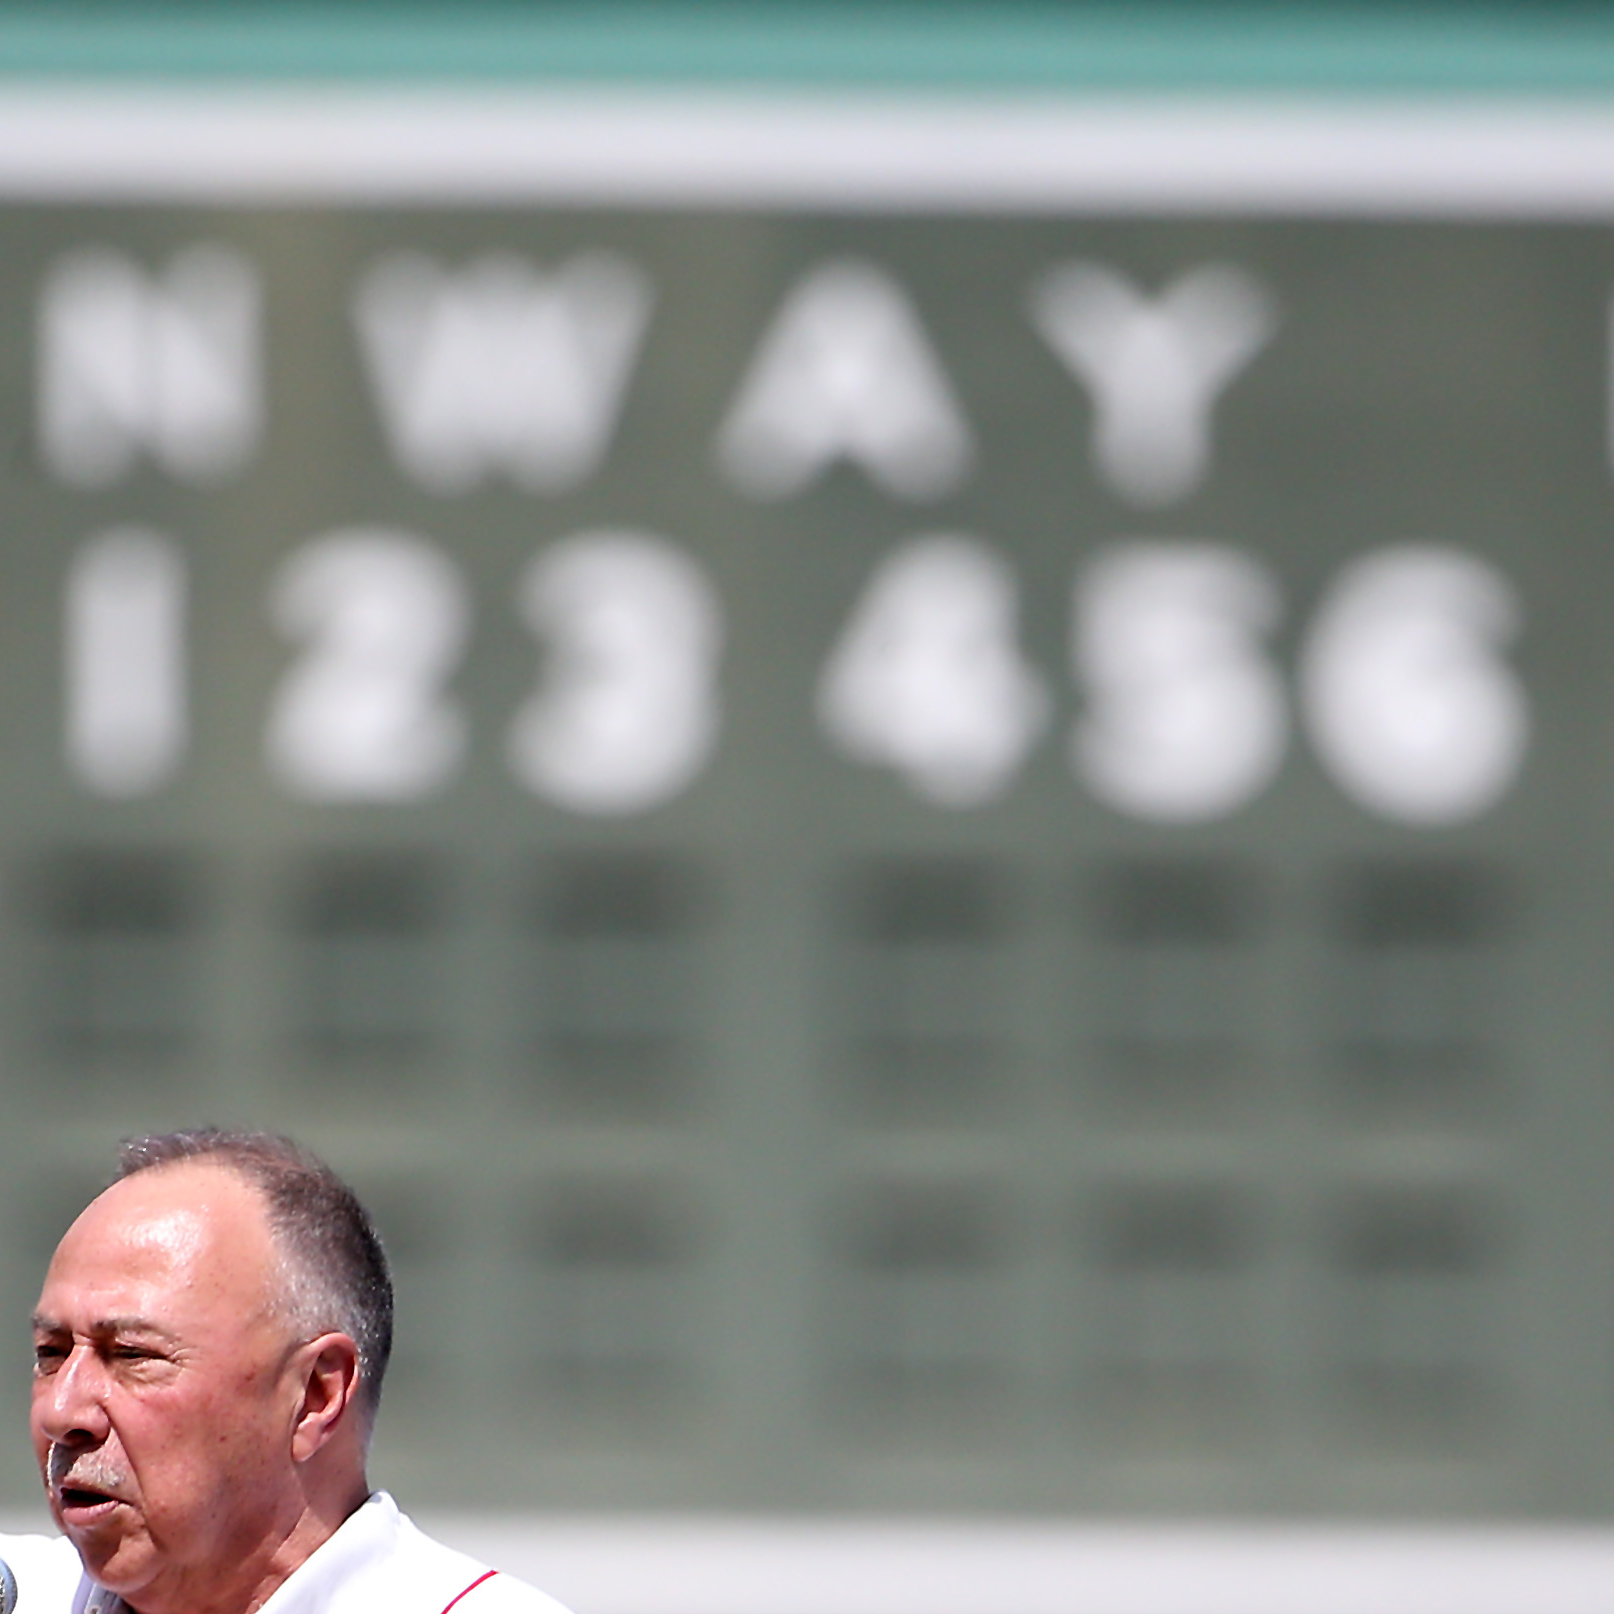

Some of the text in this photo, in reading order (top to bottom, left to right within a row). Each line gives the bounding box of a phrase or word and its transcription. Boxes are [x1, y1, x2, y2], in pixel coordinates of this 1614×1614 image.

[63, 530, 190, 798] 1
[263, 530, 465, 803] 2
[512, 532, 720, 813] 3
[818, 538, 1046, 805] 4
[1075, 543, 1288, 822] 5
[1299, 546, 1527, 825] 6
